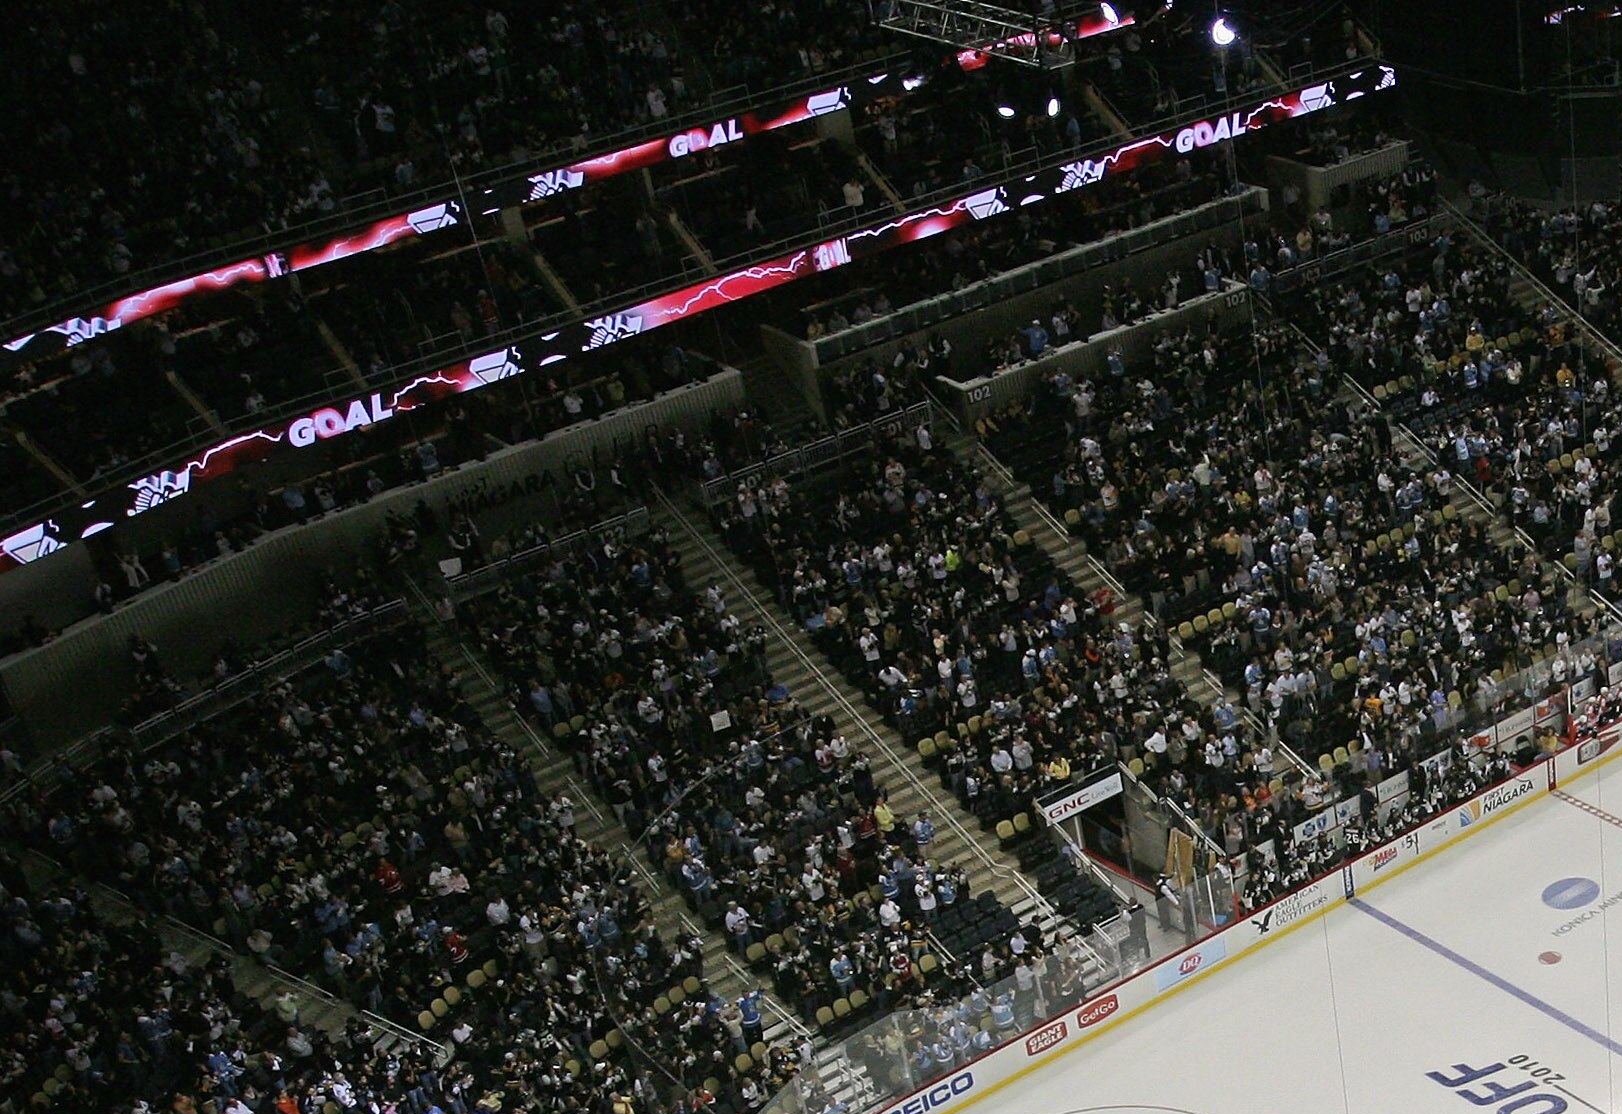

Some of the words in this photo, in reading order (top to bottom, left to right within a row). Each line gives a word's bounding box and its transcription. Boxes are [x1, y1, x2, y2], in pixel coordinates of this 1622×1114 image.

[669, 119, 743, 158] GOAL
[1176, 112, 1246, 153] GOAL
[967, 387, 993, 403] 102
[288, 393, 394, 447] GOAL
[1049, 792, 1090, 819] GNC
[1483, 780, 1534, 815] NIAGARA
[1274, 883, 1320, 912] AMERICAN
[1275, 894, 1329, 927] OUTFITTERS
[1551, 909, 1600, 938] KONICA
[1180, 954, 1200, 974] DQ
[1080, 999, 1117, 1025] GetGo
[1029, 1023, 1064, 1048] GIANT
[1030, 1034, 1064, 1056] EAGLE
[1507, 1053, 1567, 1086] 2010
